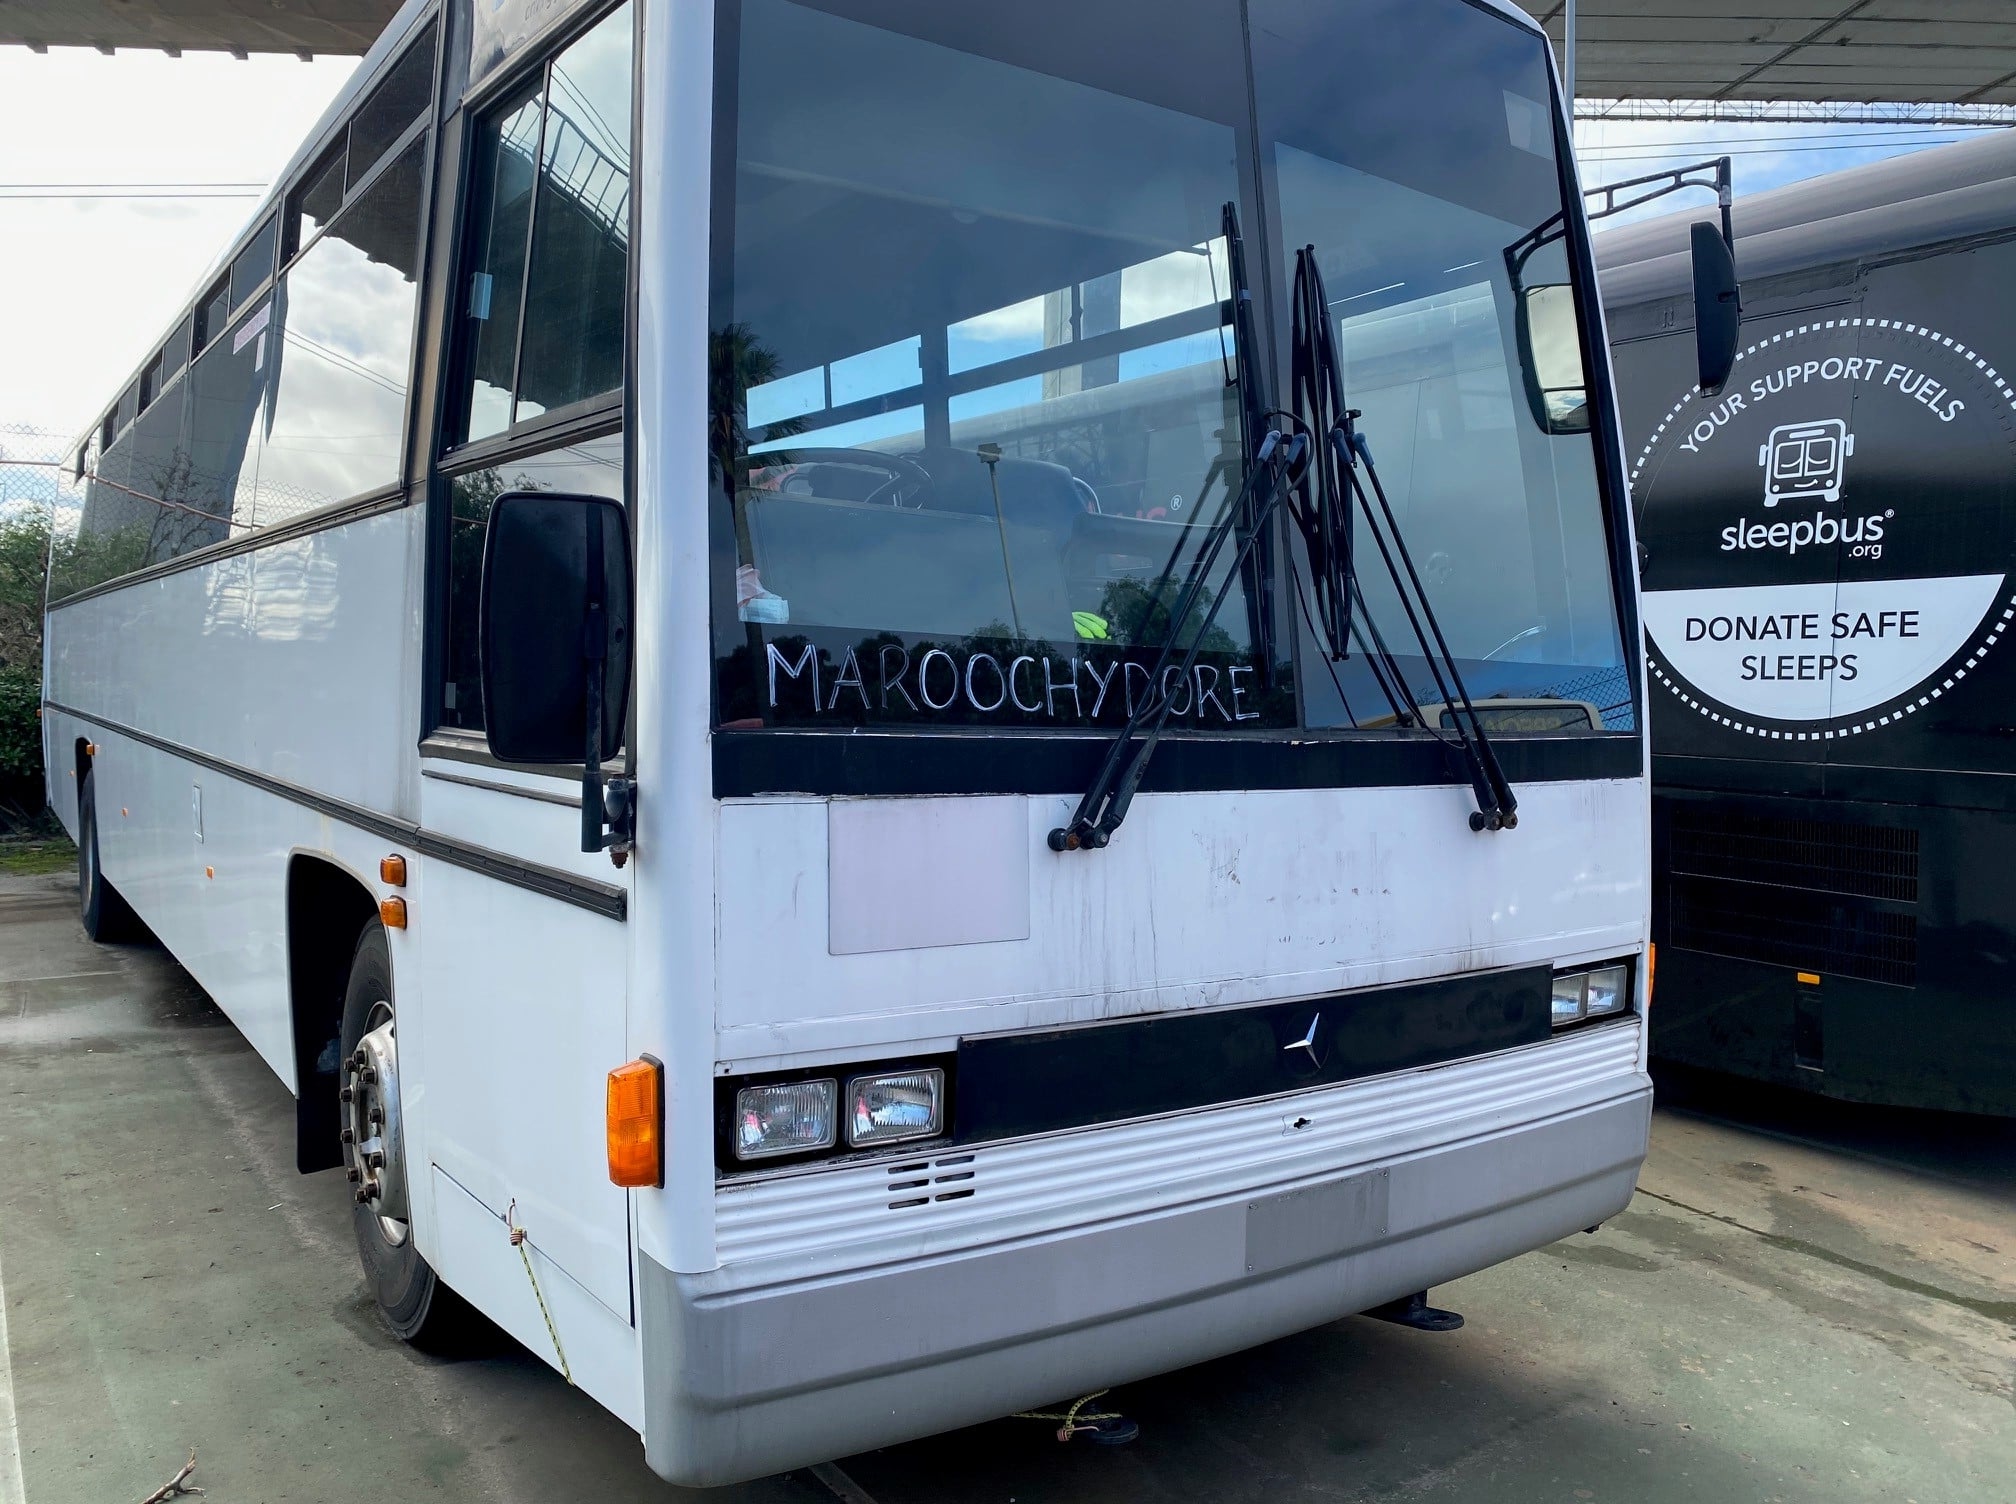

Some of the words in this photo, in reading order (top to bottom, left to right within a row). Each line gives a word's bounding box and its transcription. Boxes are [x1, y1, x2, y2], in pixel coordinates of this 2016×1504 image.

[1680, 392, 1747, 453] YOUR
[1750, 357, 1883, 401] SUPPORT
[1883, 363, 1966, 422] FUELS
[1685, 613, 1819, 642] DONATE
[1830, 610, 1920, 639] SAFE
[766, 643, 1260, 722] MAROOCHYDORE
[1740, 654, 1859, 682] SLEEPS
